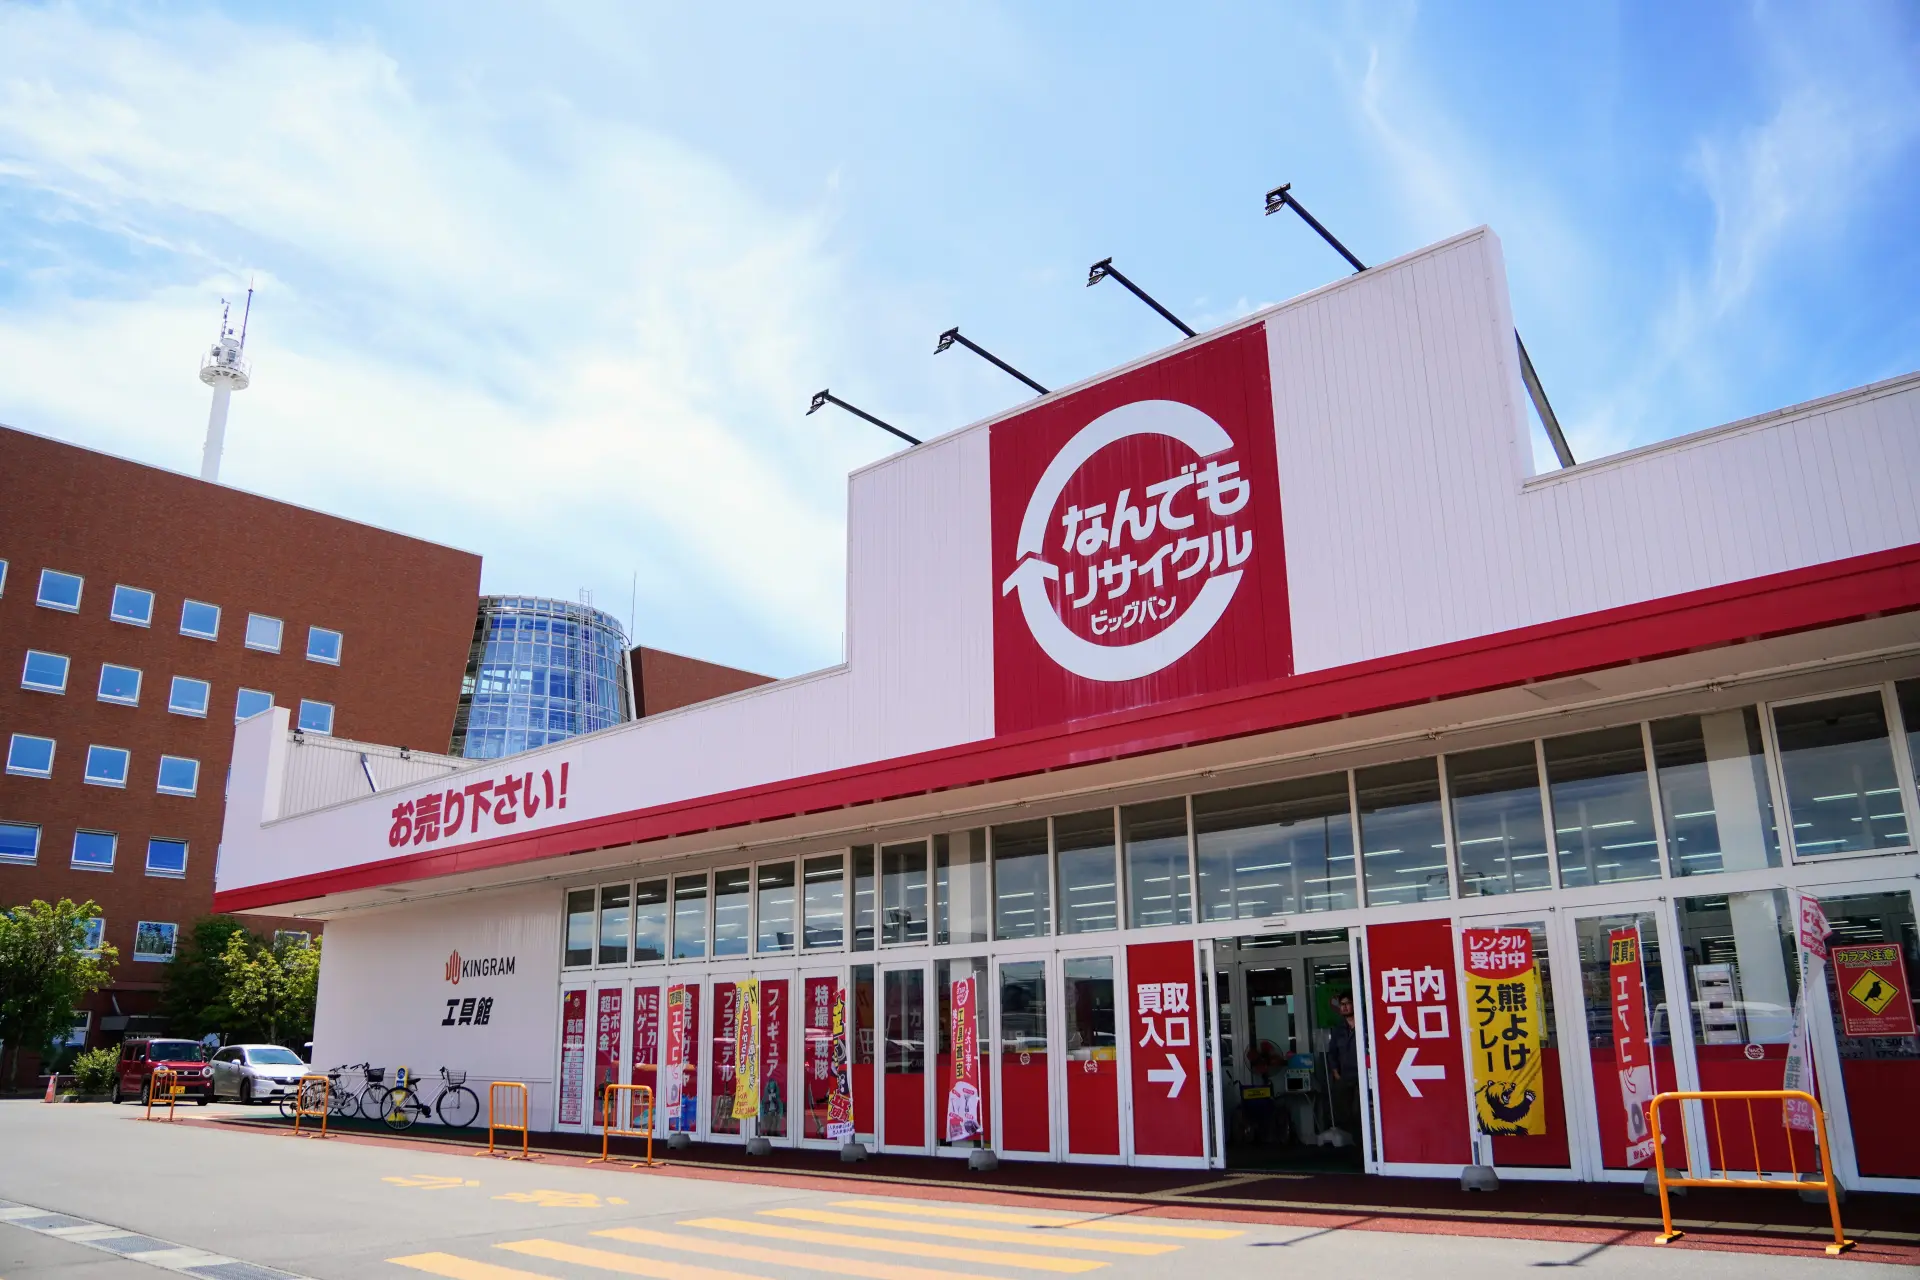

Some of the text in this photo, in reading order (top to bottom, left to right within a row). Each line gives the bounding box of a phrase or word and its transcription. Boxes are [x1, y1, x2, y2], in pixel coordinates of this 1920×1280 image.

[1062, 460, 1250, 556] なんでも
[1065, 526, 1252, 609] リサイクル
[1091, 595, 1177, 635] ビッグバン
[1469, 935, 1526, 950] レンタル
[1470, 950, 1526, 970] 受付中
[1838, 948, 1896, 963] カラス注意
[462, 956, 515, 978] KINGRAM
[1381, 965, 1446, 1004] 店内
[441, 997, 493, 1026] 工具館
[1137, 982, 1189, 1015] 買取
[567, 1019, 583, 1033] 高価
[599, 996, 611, 1051] 超合金
[609, 996, 621, 1061] ロボット
[635, 994, 647, 1064] Nゲージ
[647, 994, 658, 1064] ミニカー
[722, 989, 735, 1081] プラモデル
[766, 988, 780, 1077] フィギュア
[1139, 1017, 1190, 1048] 入口
[1384, 1005, 1450, 1041] 入口
[1475, 984, 1499, 1072] スプレー
[1496, 982, 1531, 1071] 熊よけ
